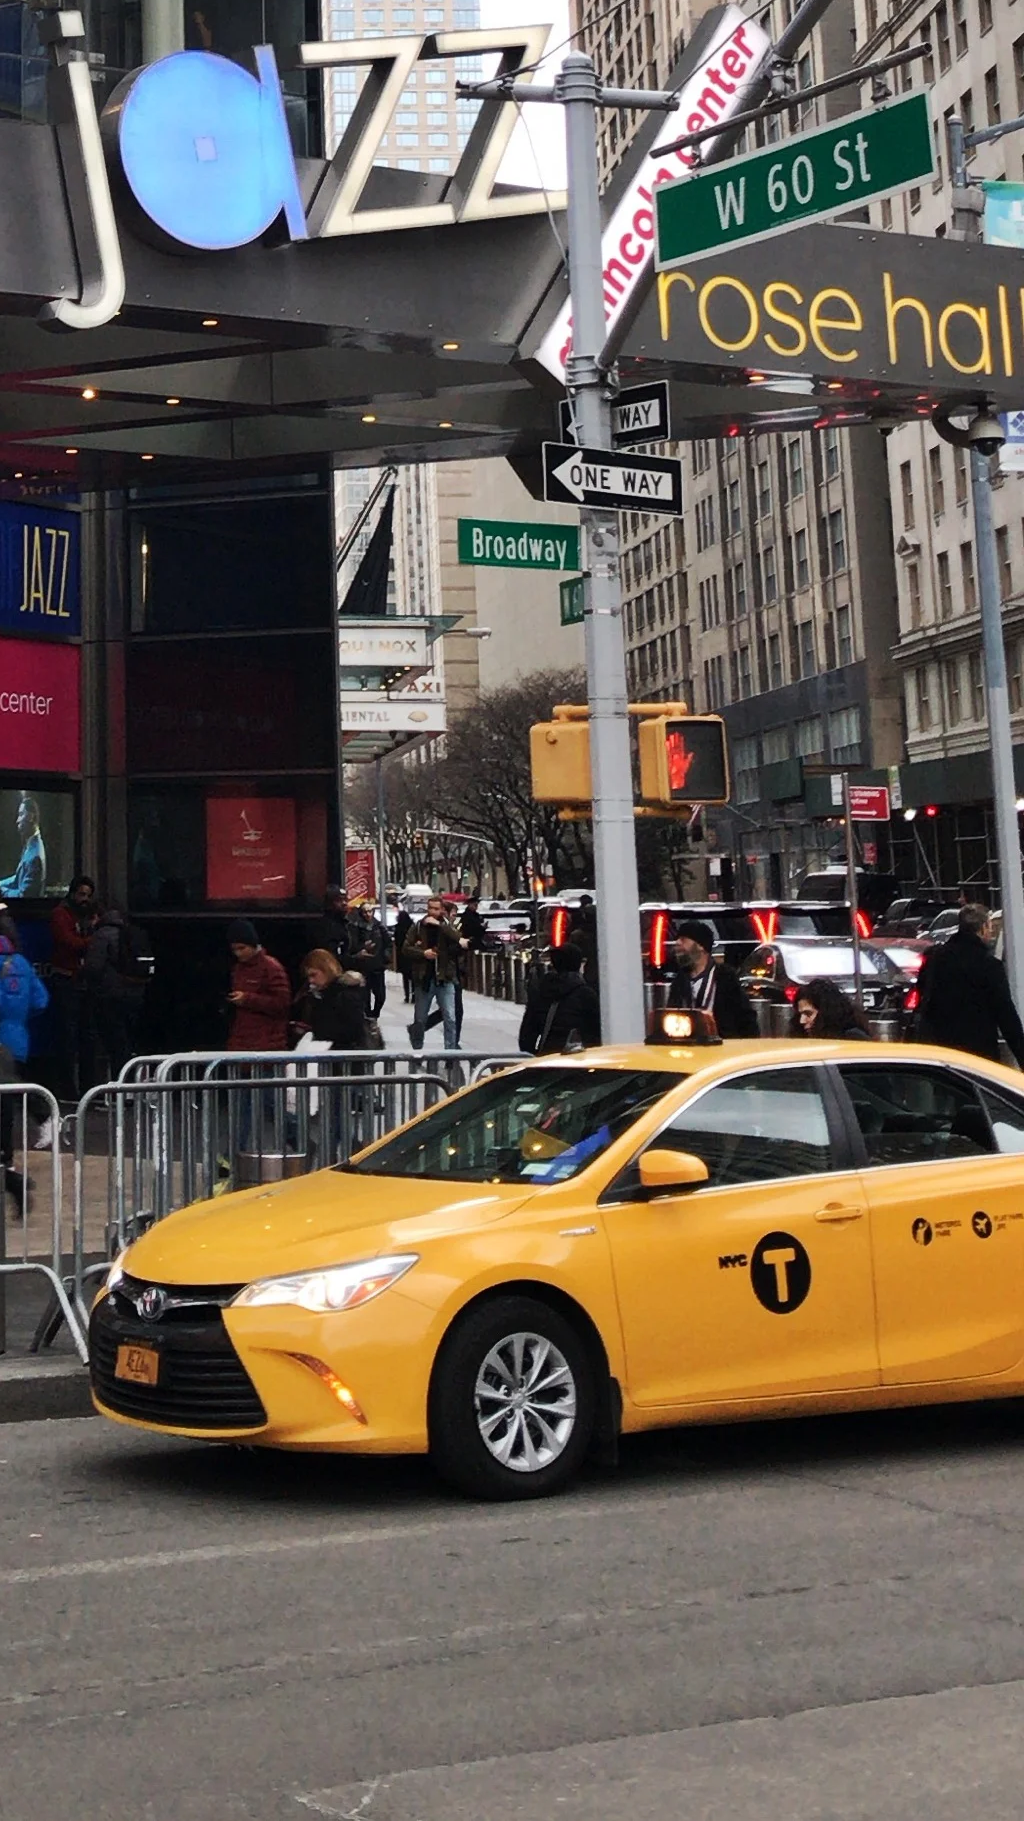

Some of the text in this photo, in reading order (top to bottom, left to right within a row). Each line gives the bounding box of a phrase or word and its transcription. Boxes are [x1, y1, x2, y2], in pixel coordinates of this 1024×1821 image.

[675, 25, 755, 166] center
[54, 10, 568, 330] jazz
[714, 132, 871, 231] W 60 St
[658, 270, 863, 363] rose
[619, 403, 652, 430] WAY
[570, 465, 663, 496] ONE WAY
[472, 527, 568, 570] Broadway
[20, 524, 71, 618] JAZZ
[0, 691, 53, 716] center
[406, 681, 442, 694] AXI
[342, 710, 391, 722] IENTAL
[718, 1254, 748, 1269] NYC
[762, 1247, 796, 1303] T
